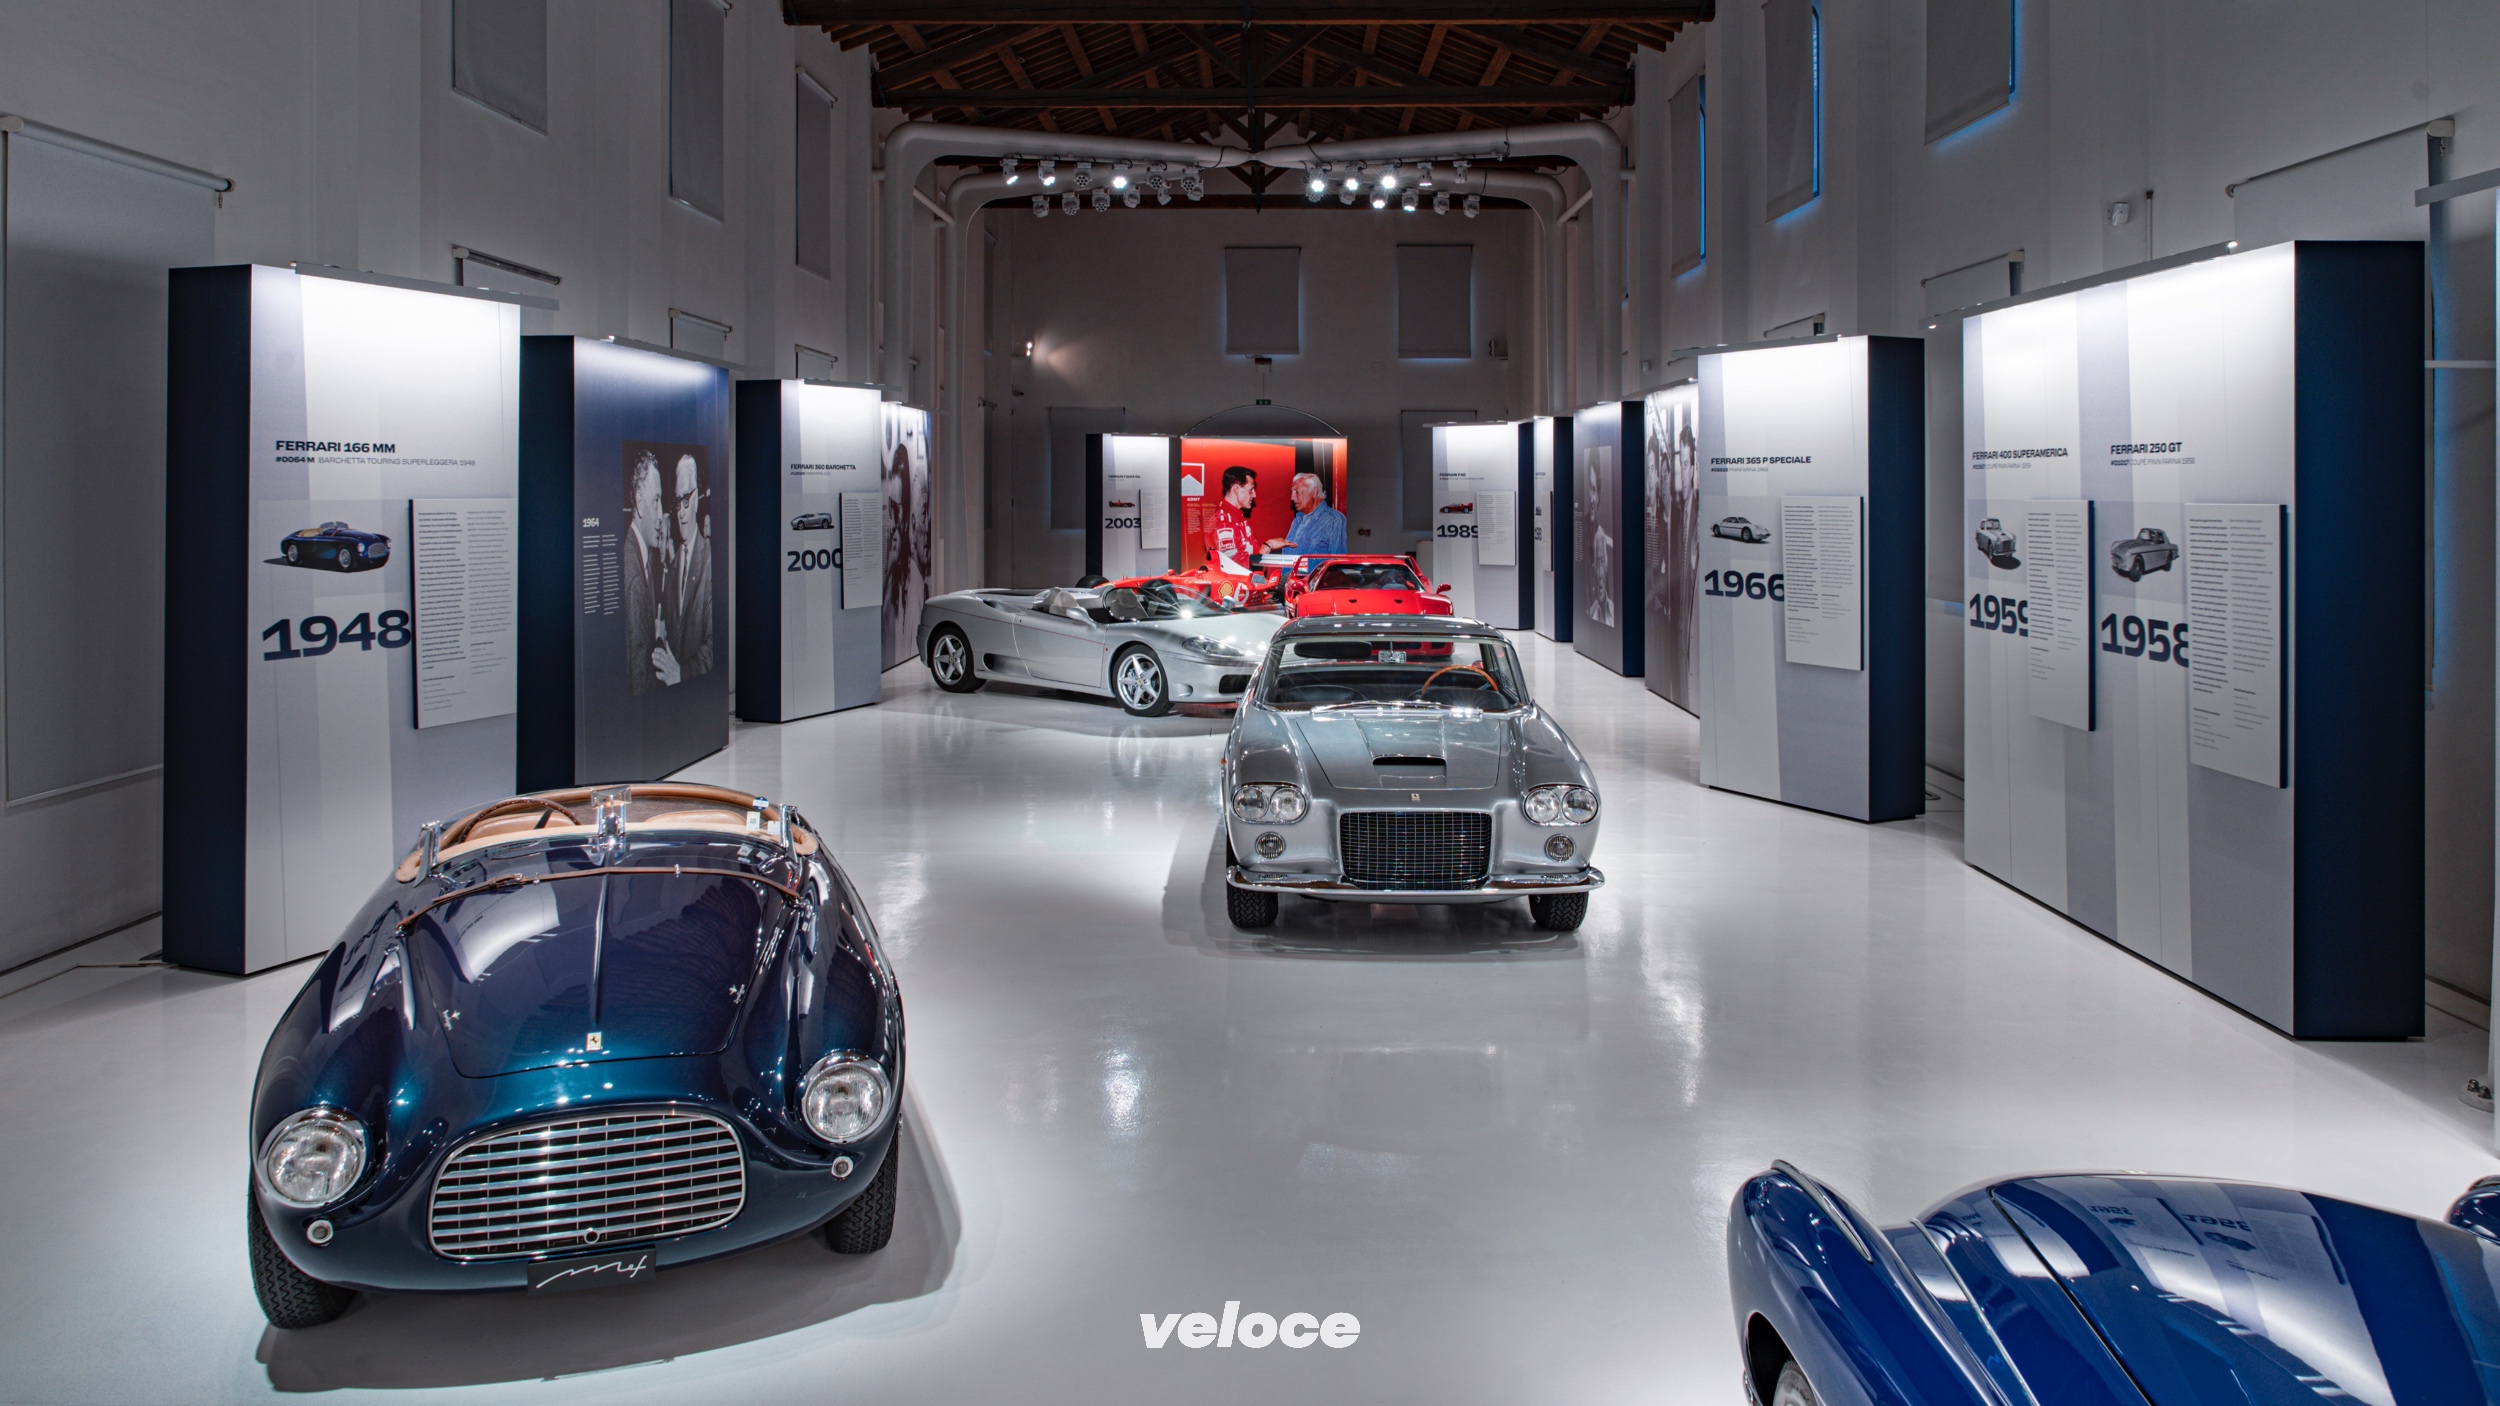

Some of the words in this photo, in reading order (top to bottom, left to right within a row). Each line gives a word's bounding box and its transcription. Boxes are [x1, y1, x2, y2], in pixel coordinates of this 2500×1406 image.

[276, 440, 341, 452] FERRARI
[344, 442, 370, 453] 166
[373, 443, 396, 453] MM
[2111, 444, 2148, 454] FERRARI
[2149, 443, 2166, 453] 250
[2168, 442, 2182, 452] GT
[1972, 451, 1998, 460] FERRARI
[2000, 450, 2012, 459] 400
[2013, 448, 2068, 458] SUPERAMERICA
[583, 518, 599, 527] 1964
[1105, 518, 1141, 528] 2003
[1437, 524, 1478, 538] 1989
[787, 548, 842, 572] 2000
[1704, 570, 1784, 602] 1966
[1970, 593, 2028, 637] 1959
[262, 609, 412, 661] 1948
[2102, 613, 2189, 668] 1958
